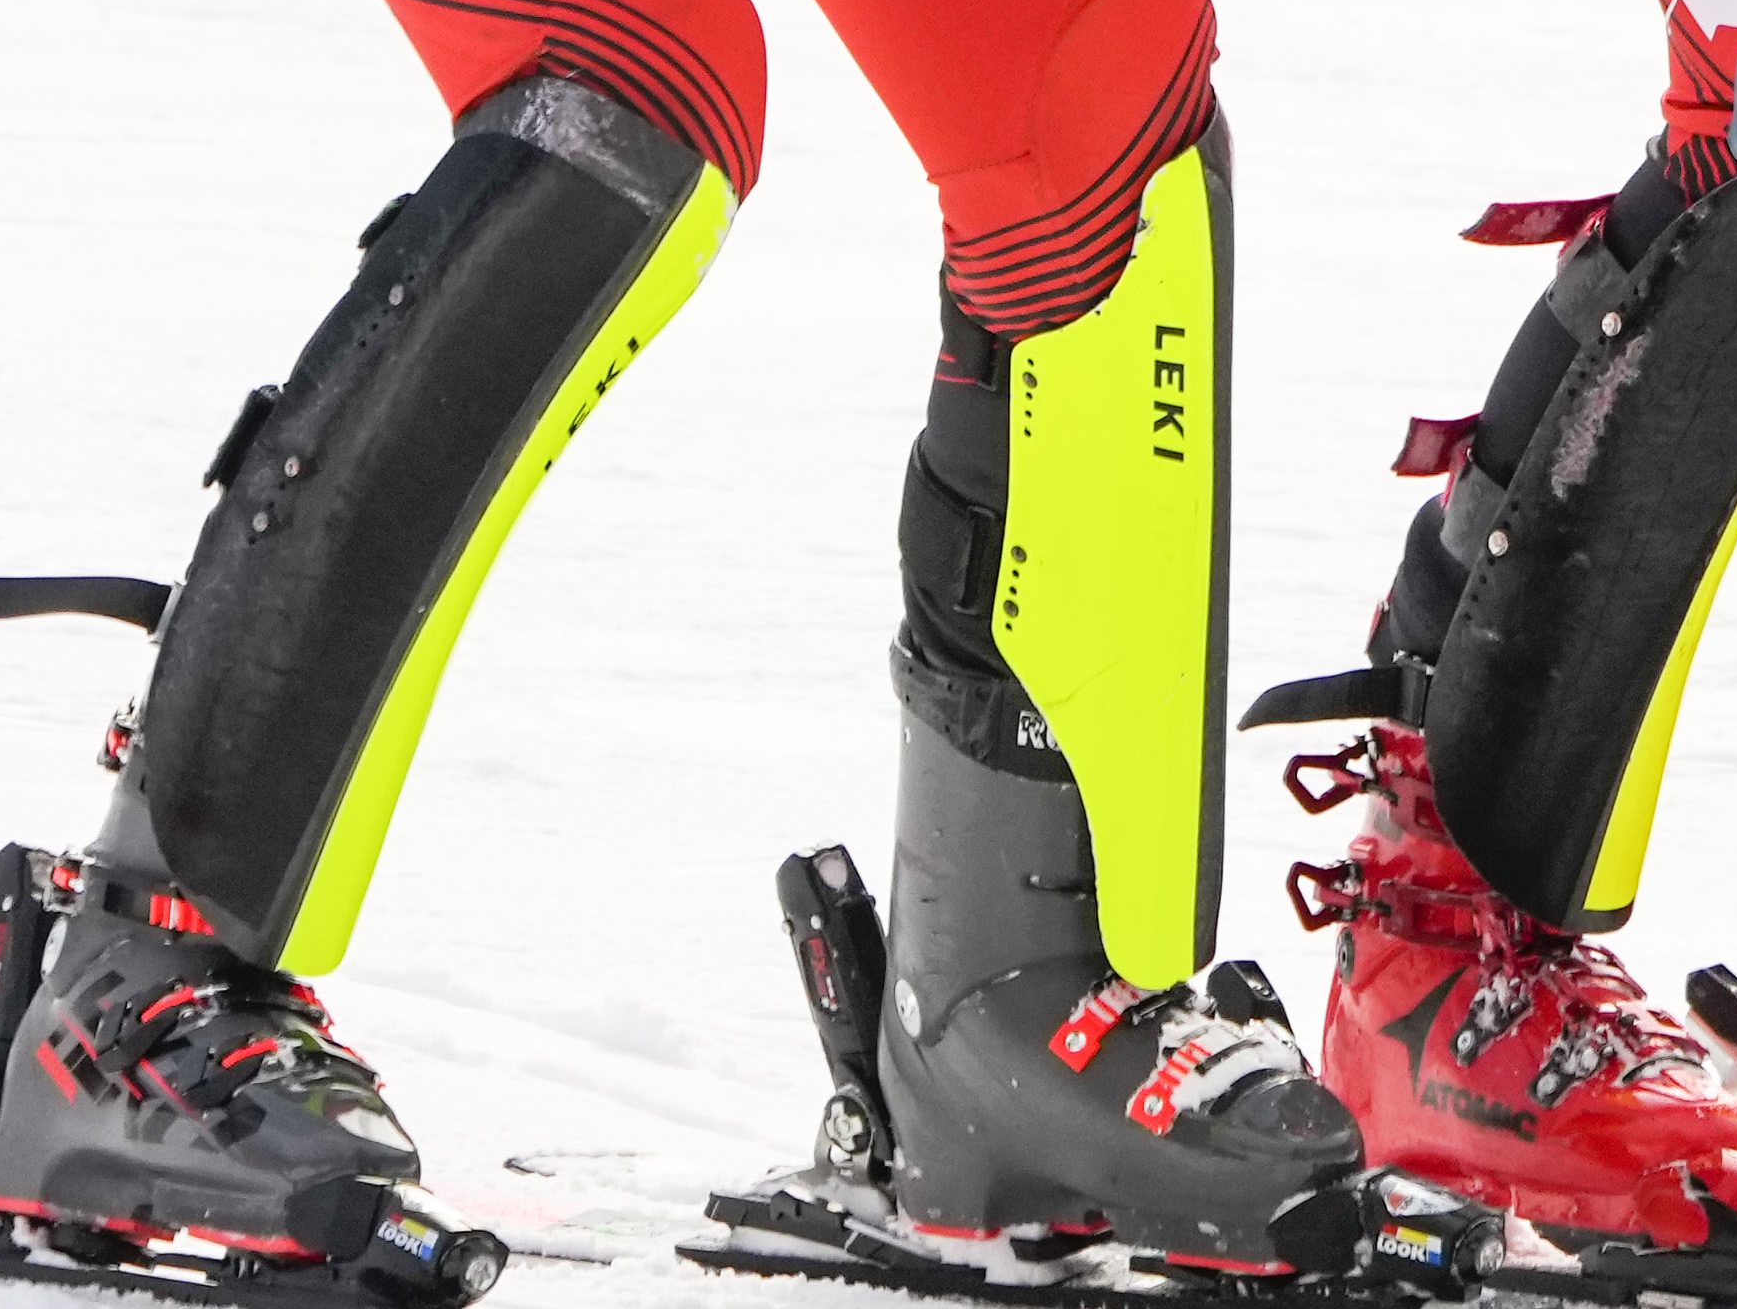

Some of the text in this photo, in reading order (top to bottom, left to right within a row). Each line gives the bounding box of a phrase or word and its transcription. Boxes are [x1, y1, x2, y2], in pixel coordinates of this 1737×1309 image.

[1153, 324, 1185, 464] LEKI
[1421, 1080, 1539, 1143] ATOMIC
[377, 1220, 423, 1257] LOOK
[1377, 1230, 1426, 1263] LOOK
